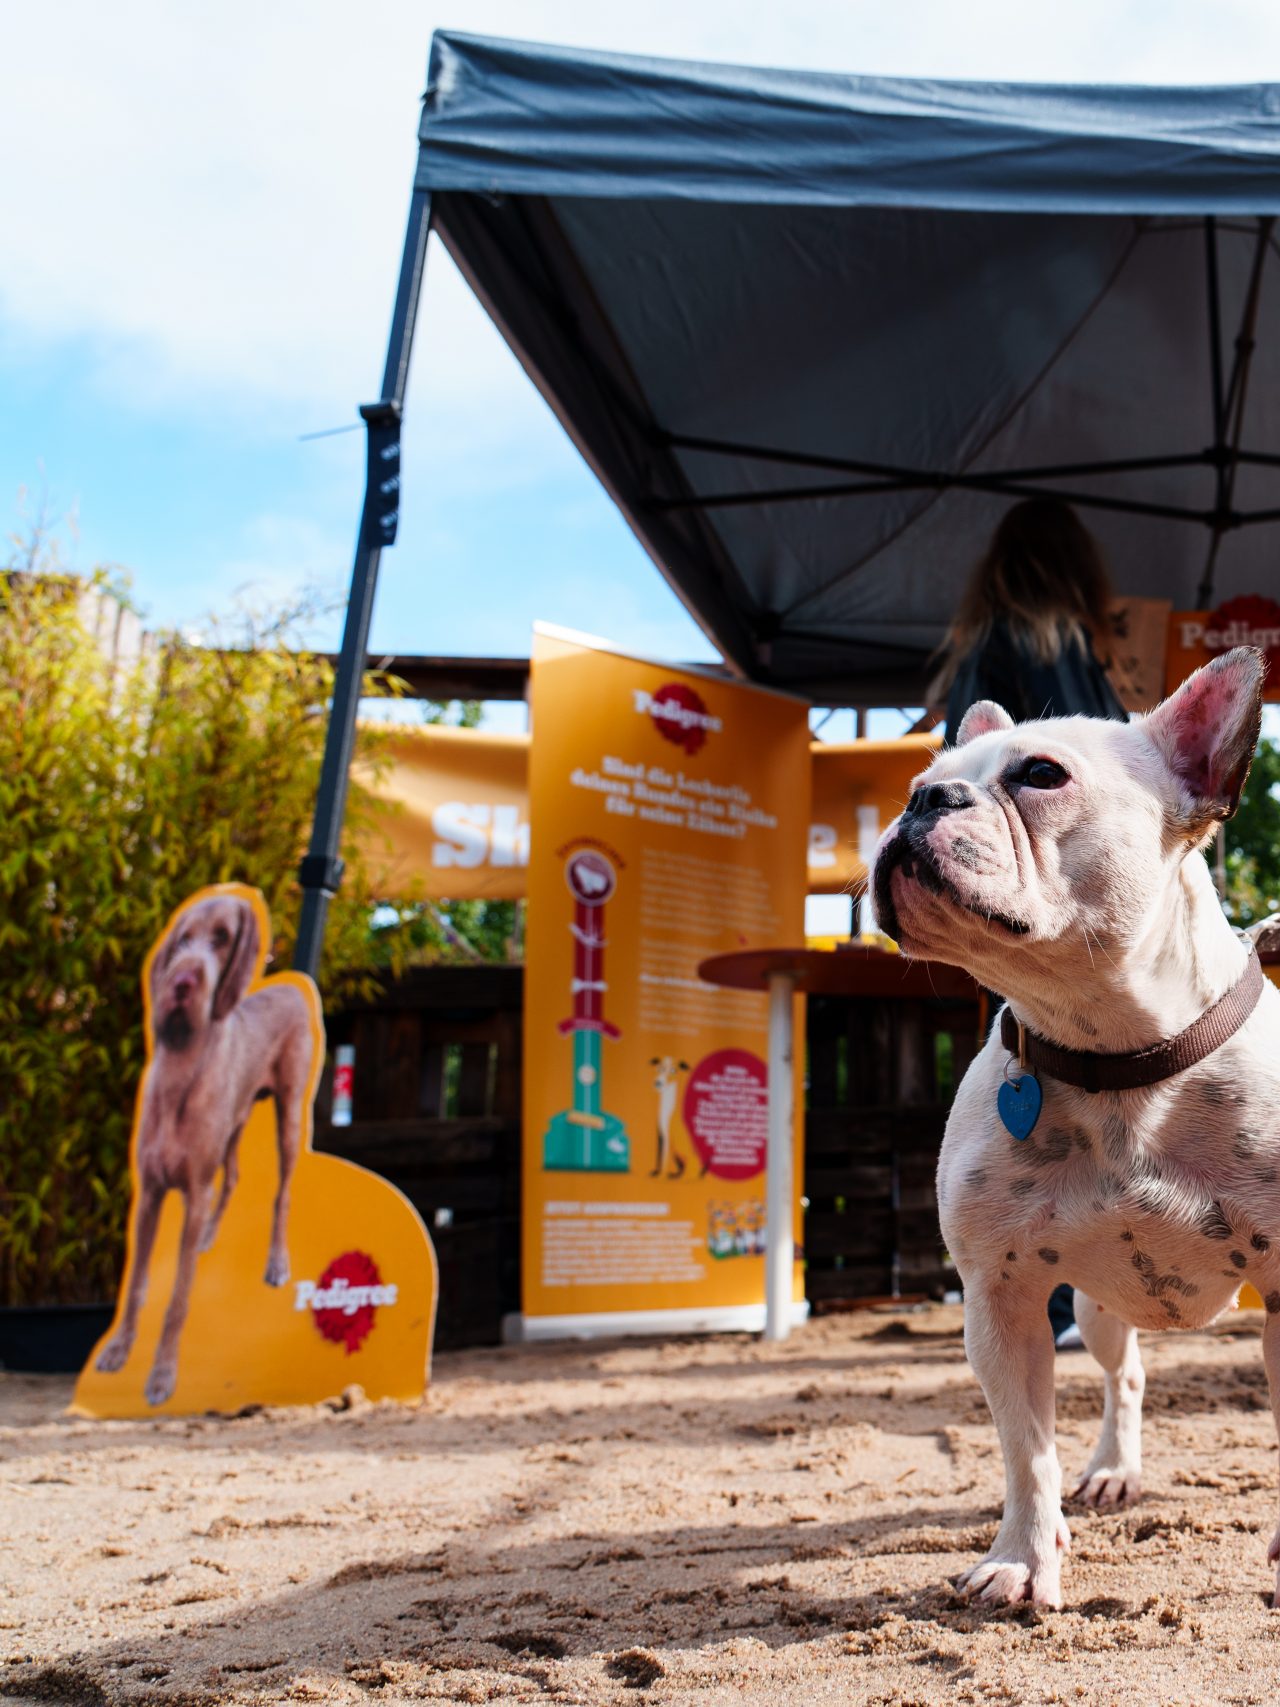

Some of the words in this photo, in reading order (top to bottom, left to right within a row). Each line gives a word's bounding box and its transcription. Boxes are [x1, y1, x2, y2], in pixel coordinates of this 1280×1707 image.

[632, 689, 723, 734] Pedigree
[431, 801, 530, 869] Sh
[293, 1277, 398, 1316] Pedigree
